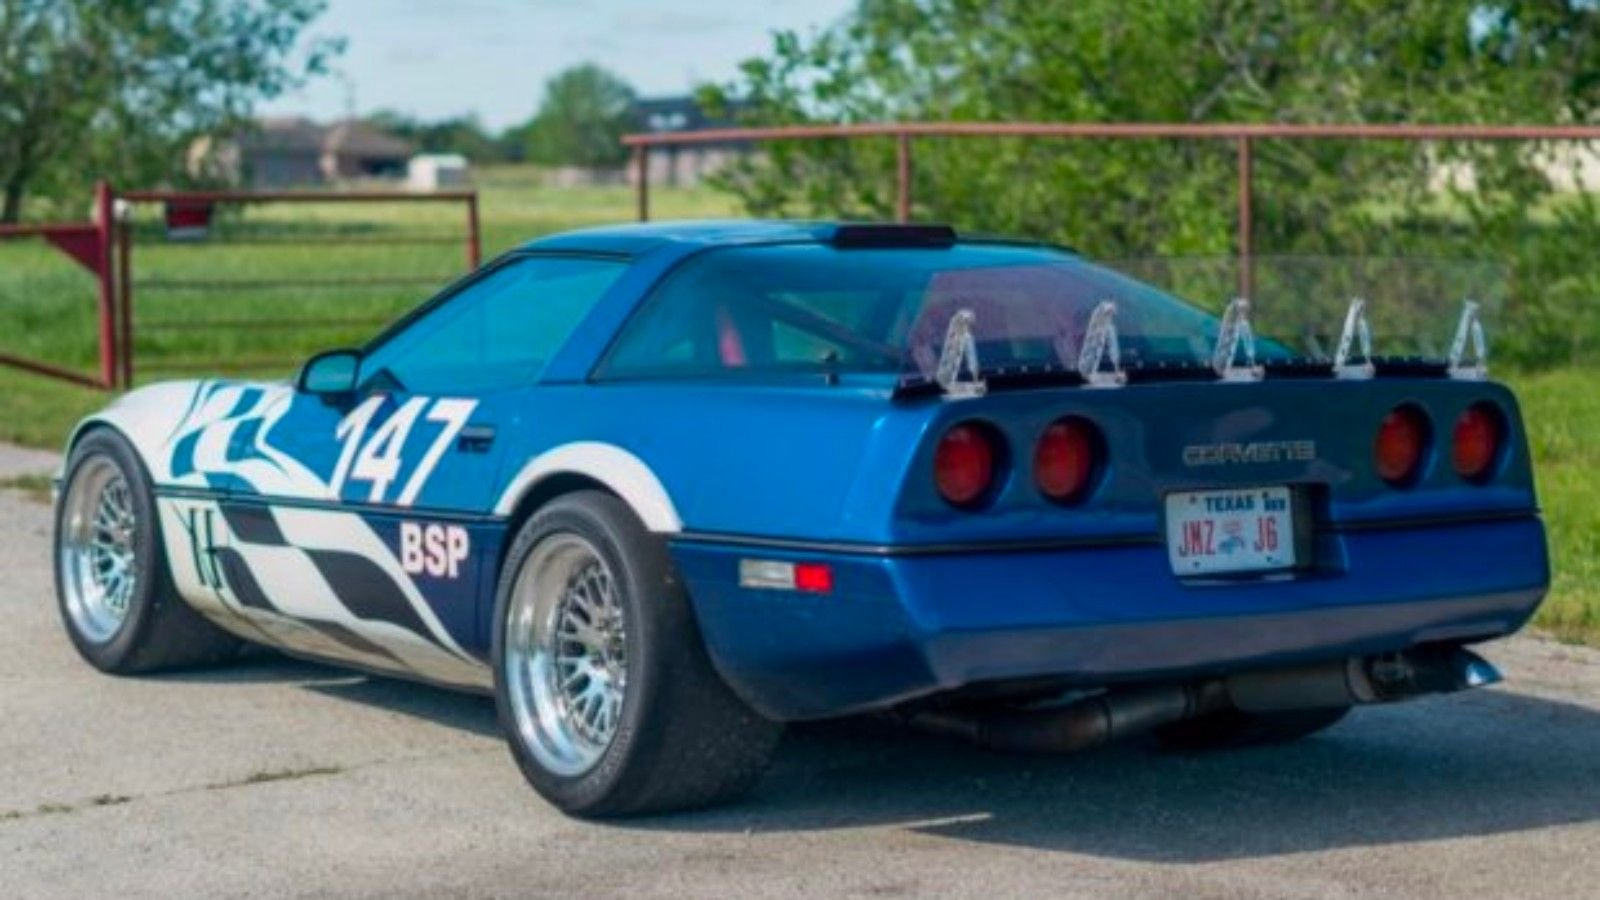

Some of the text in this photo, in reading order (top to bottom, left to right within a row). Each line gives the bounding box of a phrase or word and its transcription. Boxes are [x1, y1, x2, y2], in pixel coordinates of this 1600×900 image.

[329, 395, 480, 506] 147
[1183, 440, 1316, 467] CORVETTE
[1205, 495, 1255, 512] TEXAS
[400, 521, 470, 578] BSP
